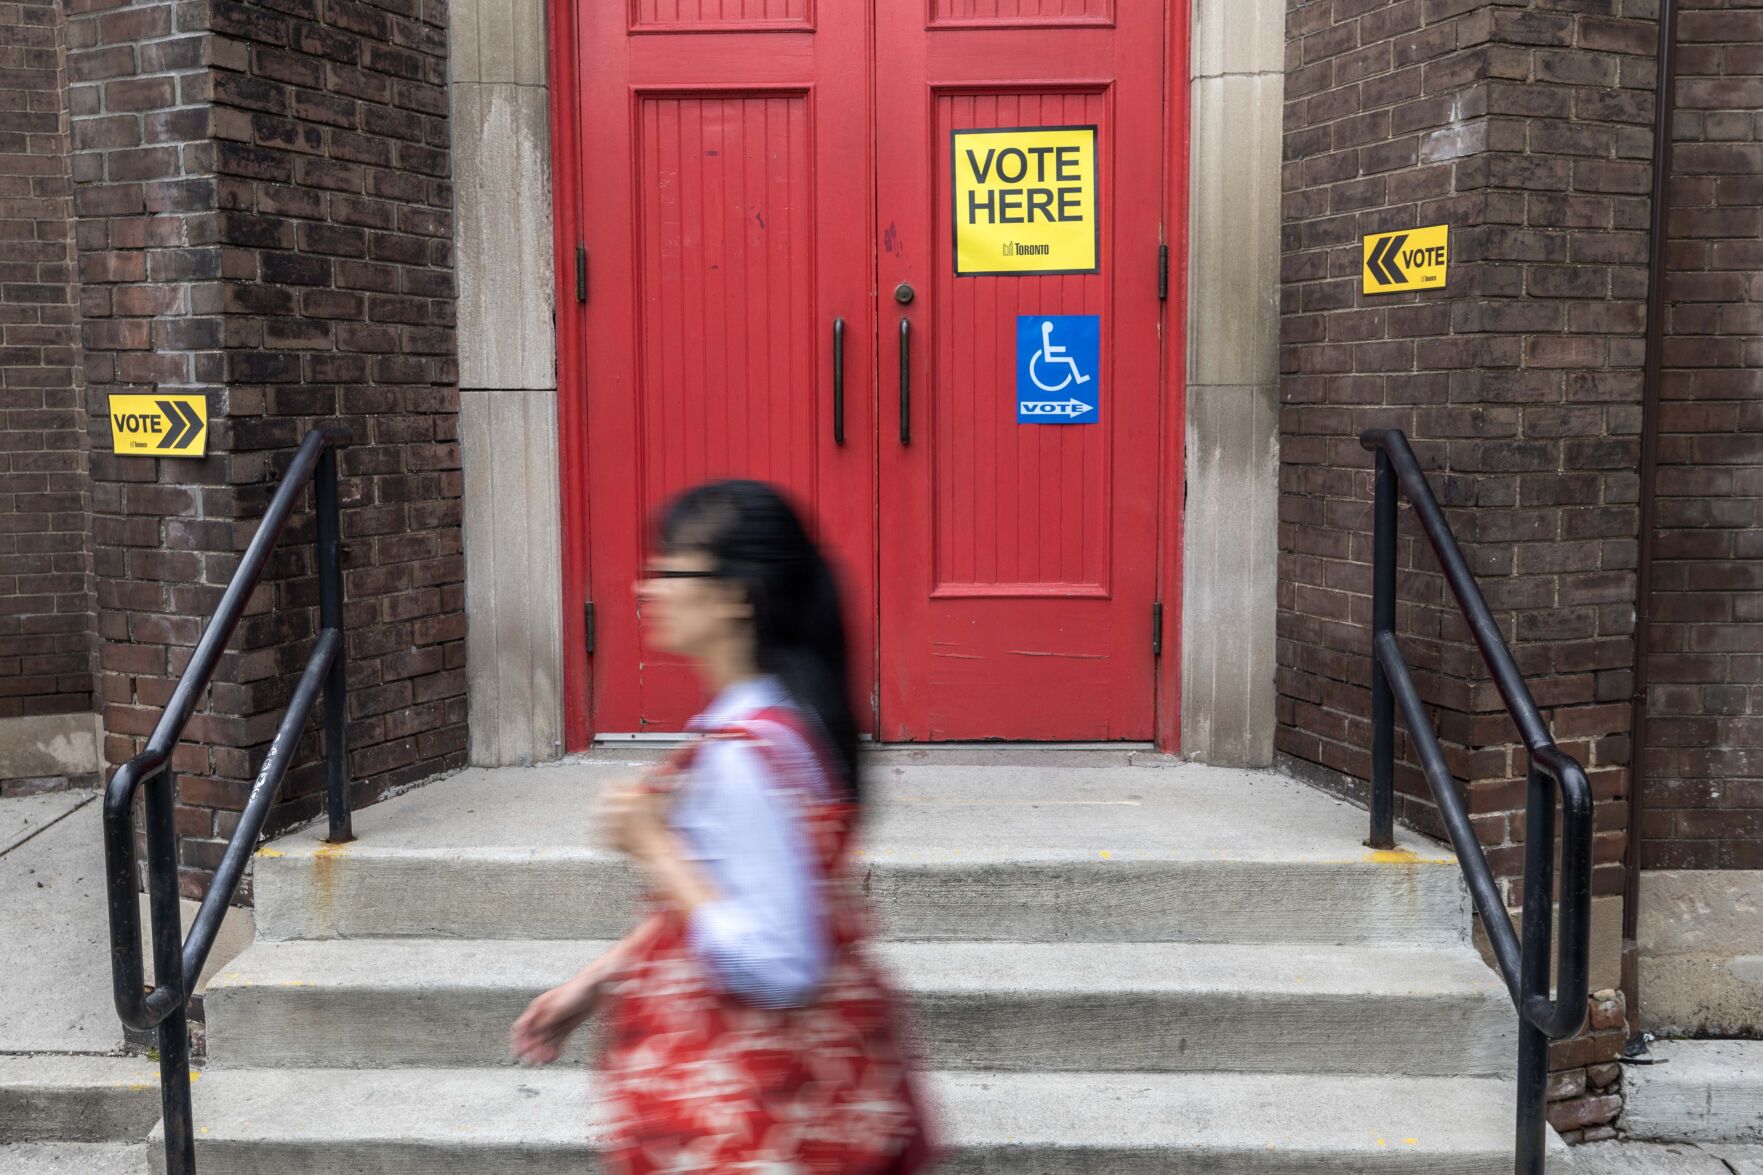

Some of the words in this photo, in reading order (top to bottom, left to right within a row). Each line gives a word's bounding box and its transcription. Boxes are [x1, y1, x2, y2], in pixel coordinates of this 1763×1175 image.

[966, 146, 1081, 184] VOTE
[968, 187, 1083, 224] HERE
[1015, 243, 1049, 256] TORONTO
[1402, 246, 1445, 269] VOTE
[1022, 404, 1083, 413] VOTE
[113, 413, 162, 433] VOTE
